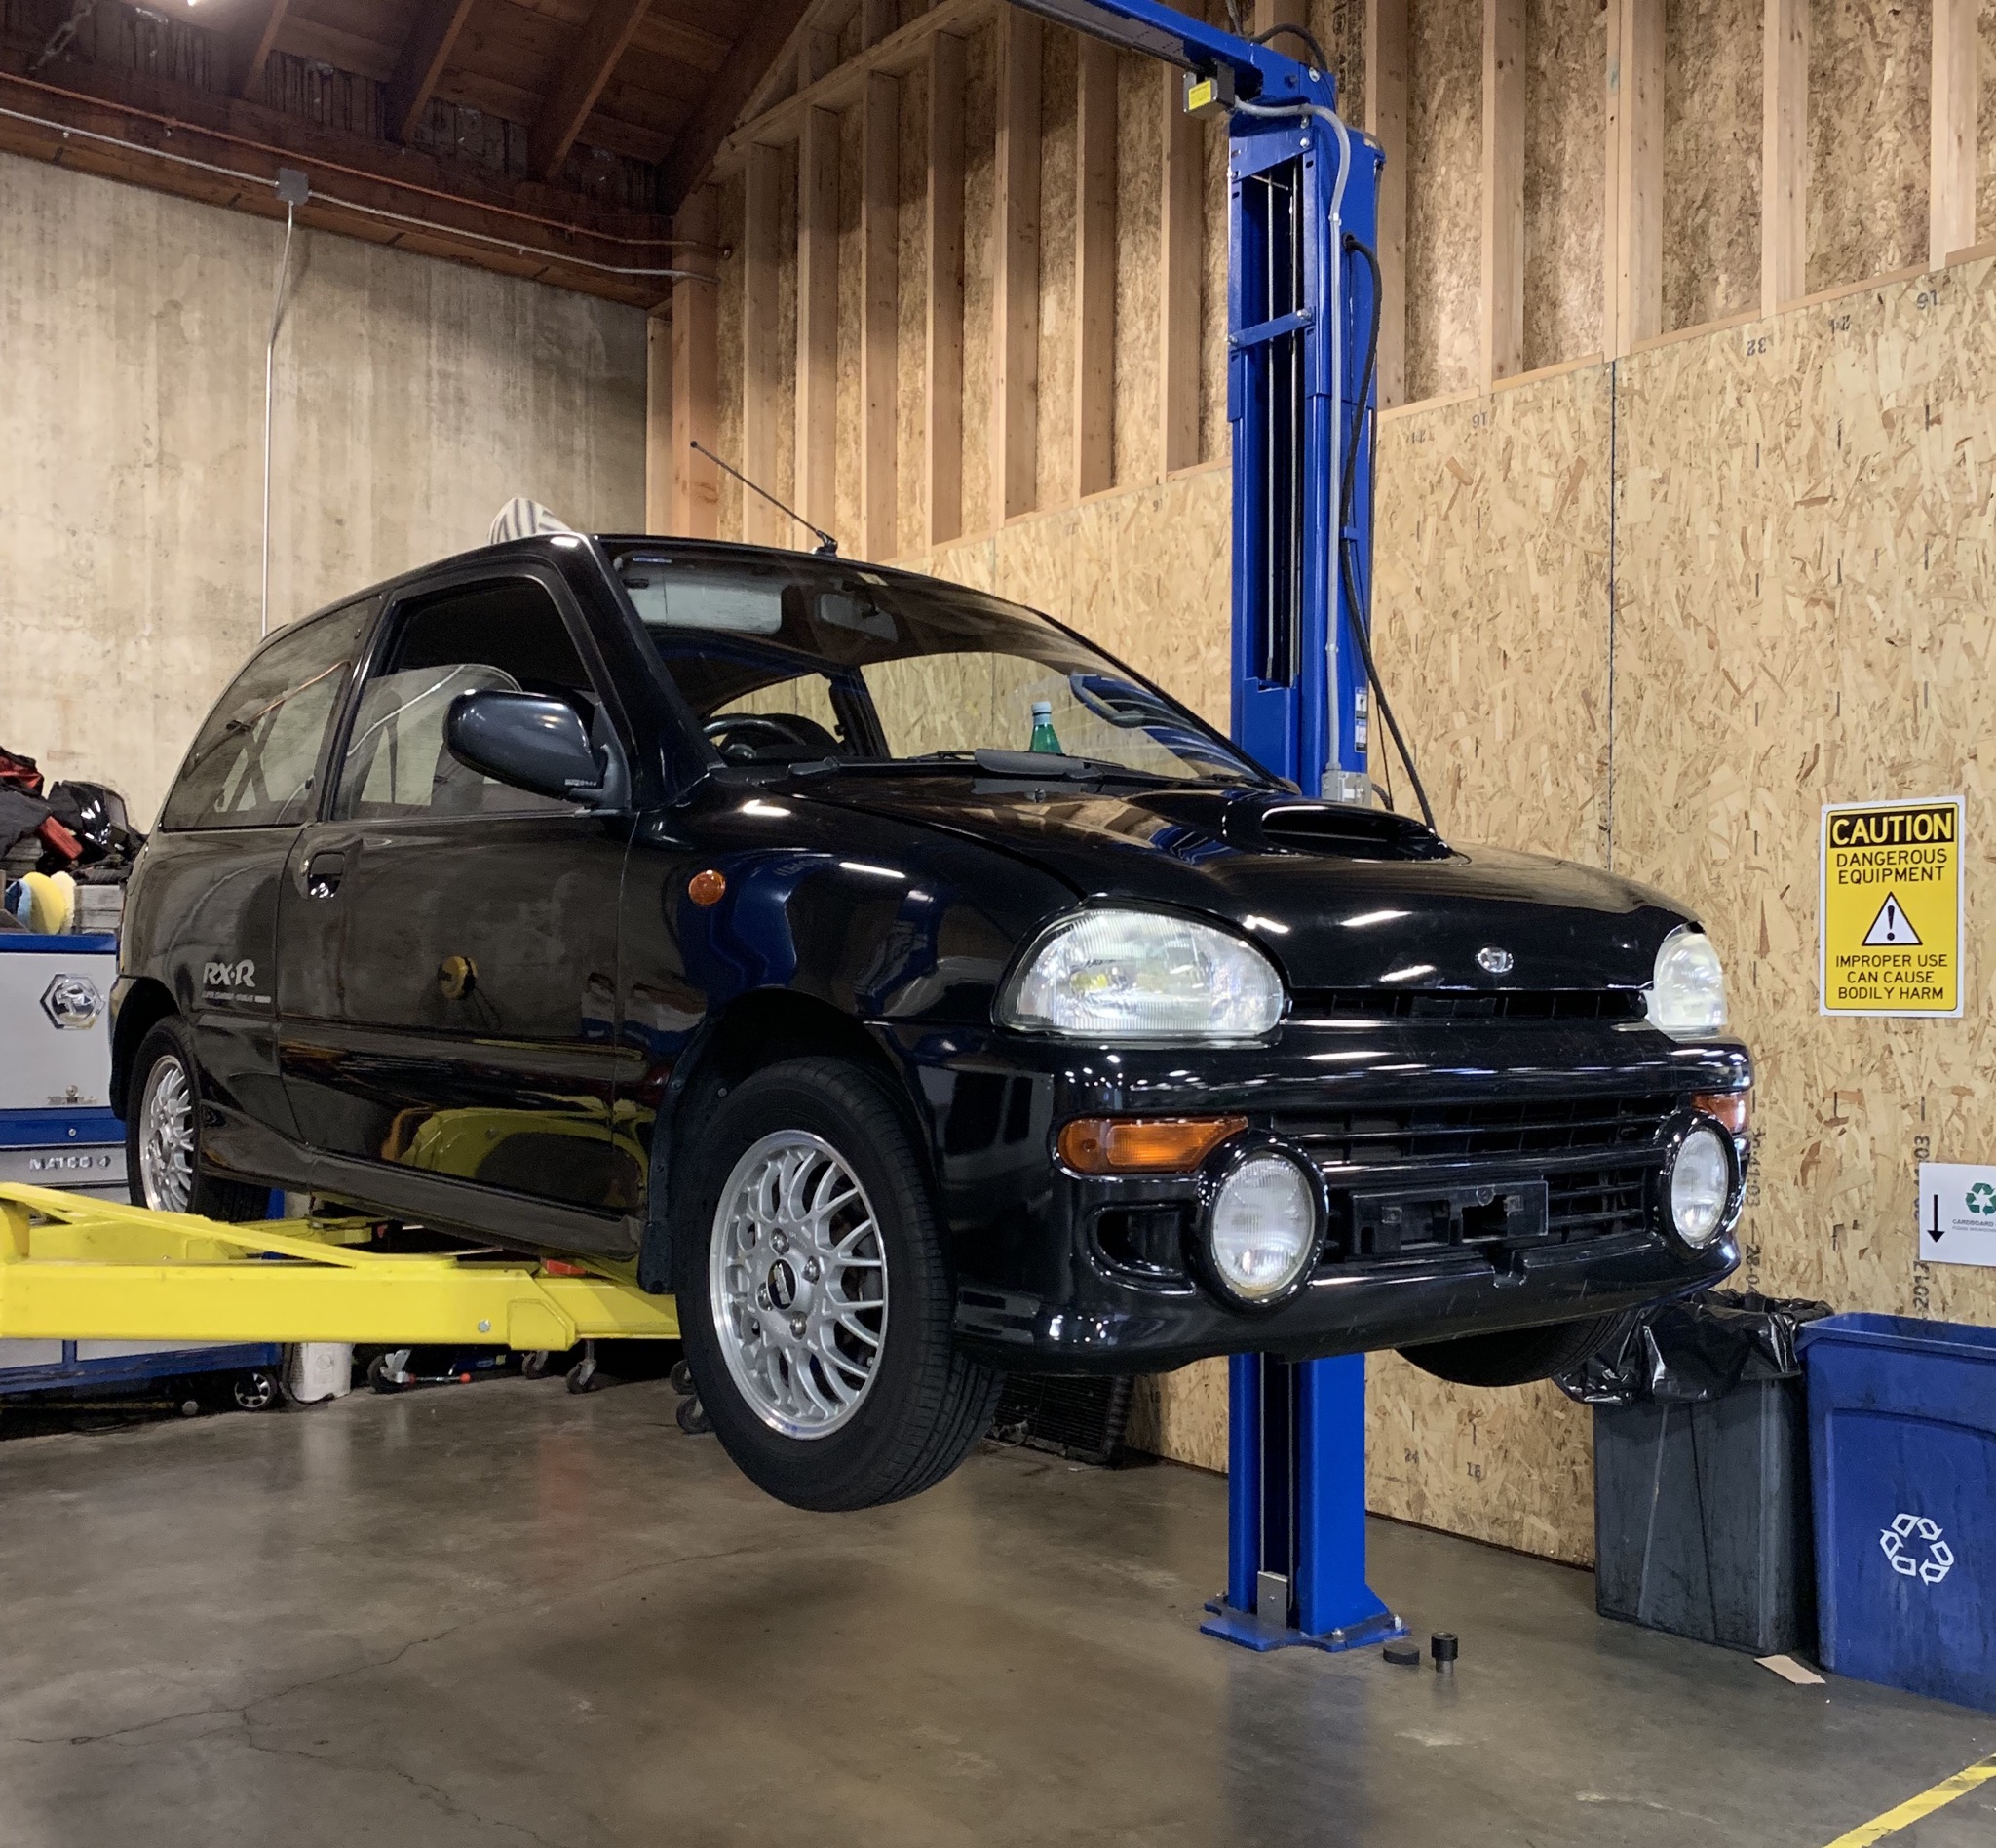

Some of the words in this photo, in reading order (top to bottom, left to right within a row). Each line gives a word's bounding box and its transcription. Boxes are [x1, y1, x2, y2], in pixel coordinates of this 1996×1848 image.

[1831, 812, 1953, 846] CAUTION
[1836, 849, 1947, 867] DANGEROUS
[1838, 866, 1945, 885] EQUIPMENT
[1835, 954, 1912, 968] IMPROPER
[1917, 954, 1948, 968] USE
[1847, 971, 1878, 983] CAN
[1883, 971, 1935, 983] CAUSE
[1838, 987, 1895, 1000] BODILY
[1900, 987, 1944, 1000] HARM
[29, 1156, 93, 1170] MATCO
[1951, 1218, 1994, 1227] CARDBOARD
